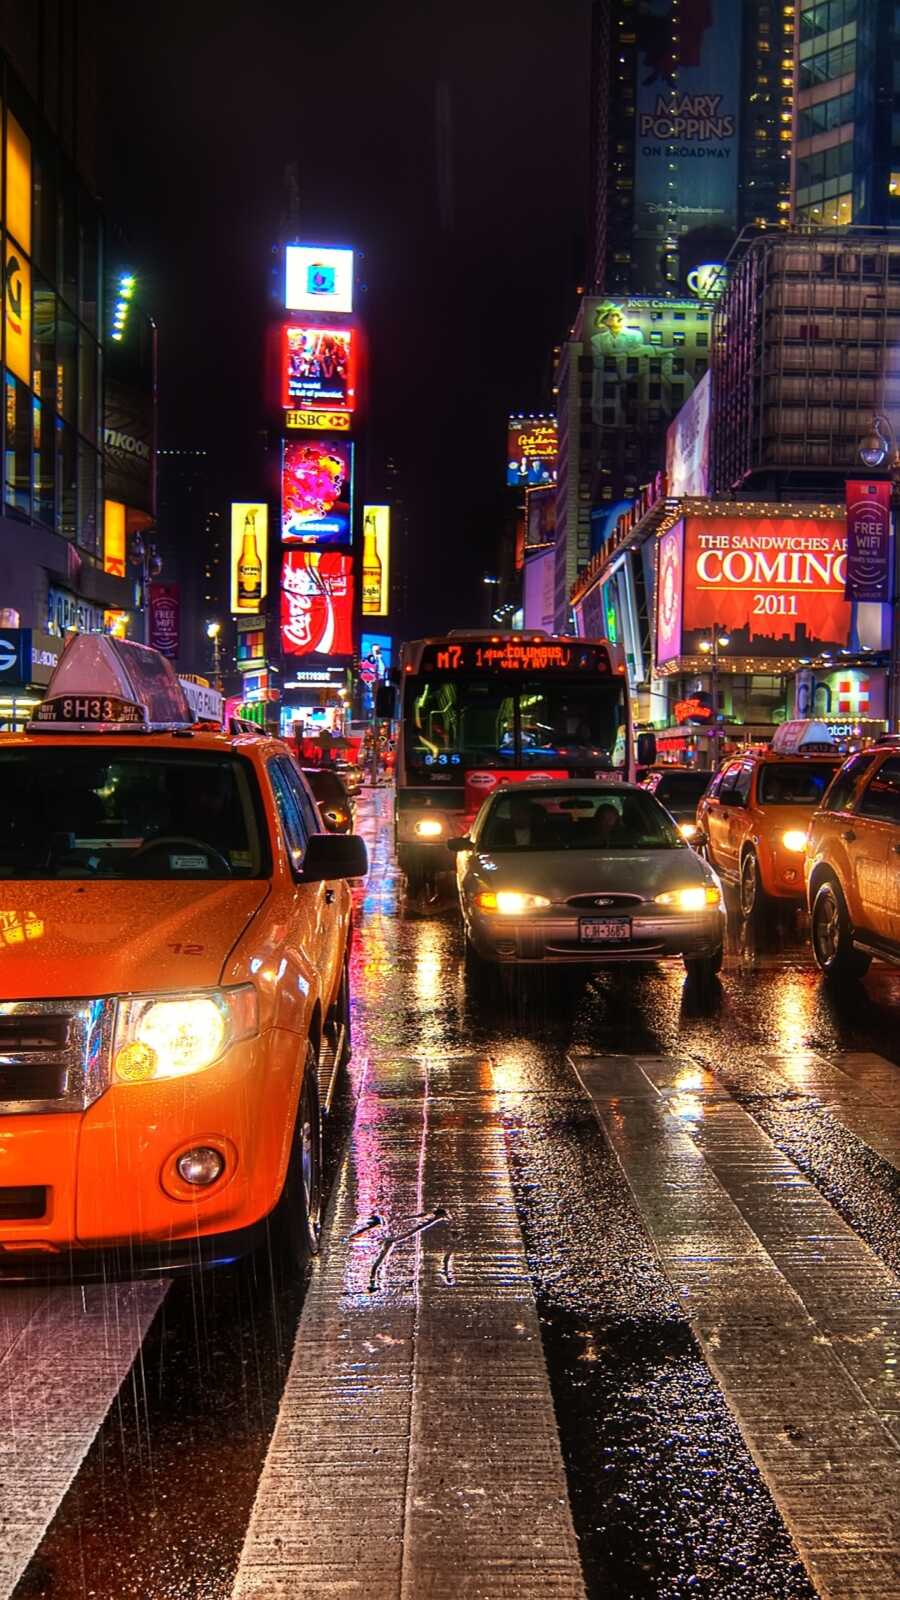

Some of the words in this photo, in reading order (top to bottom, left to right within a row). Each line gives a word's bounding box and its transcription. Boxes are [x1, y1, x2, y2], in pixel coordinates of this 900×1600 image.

[656, 96, 720, 117] MARY
[640, 115, 735, 140] POPPINS
[642, 146, 660, 157] ON
[665, 146, 731, 158] BROADWAY
[287, 413, 327, 426] HSBC
[854, 521, 883, 536] FREE
[698, 535, 729, 549] THE
[731, 536, 829, 551] SANDWICHES
[855, 536, 881, 549] WIFI
[752, 594, 798, 615] 2011
[437, 645, 462, 669] M7
[63, 699, 113, 718] 8H33
